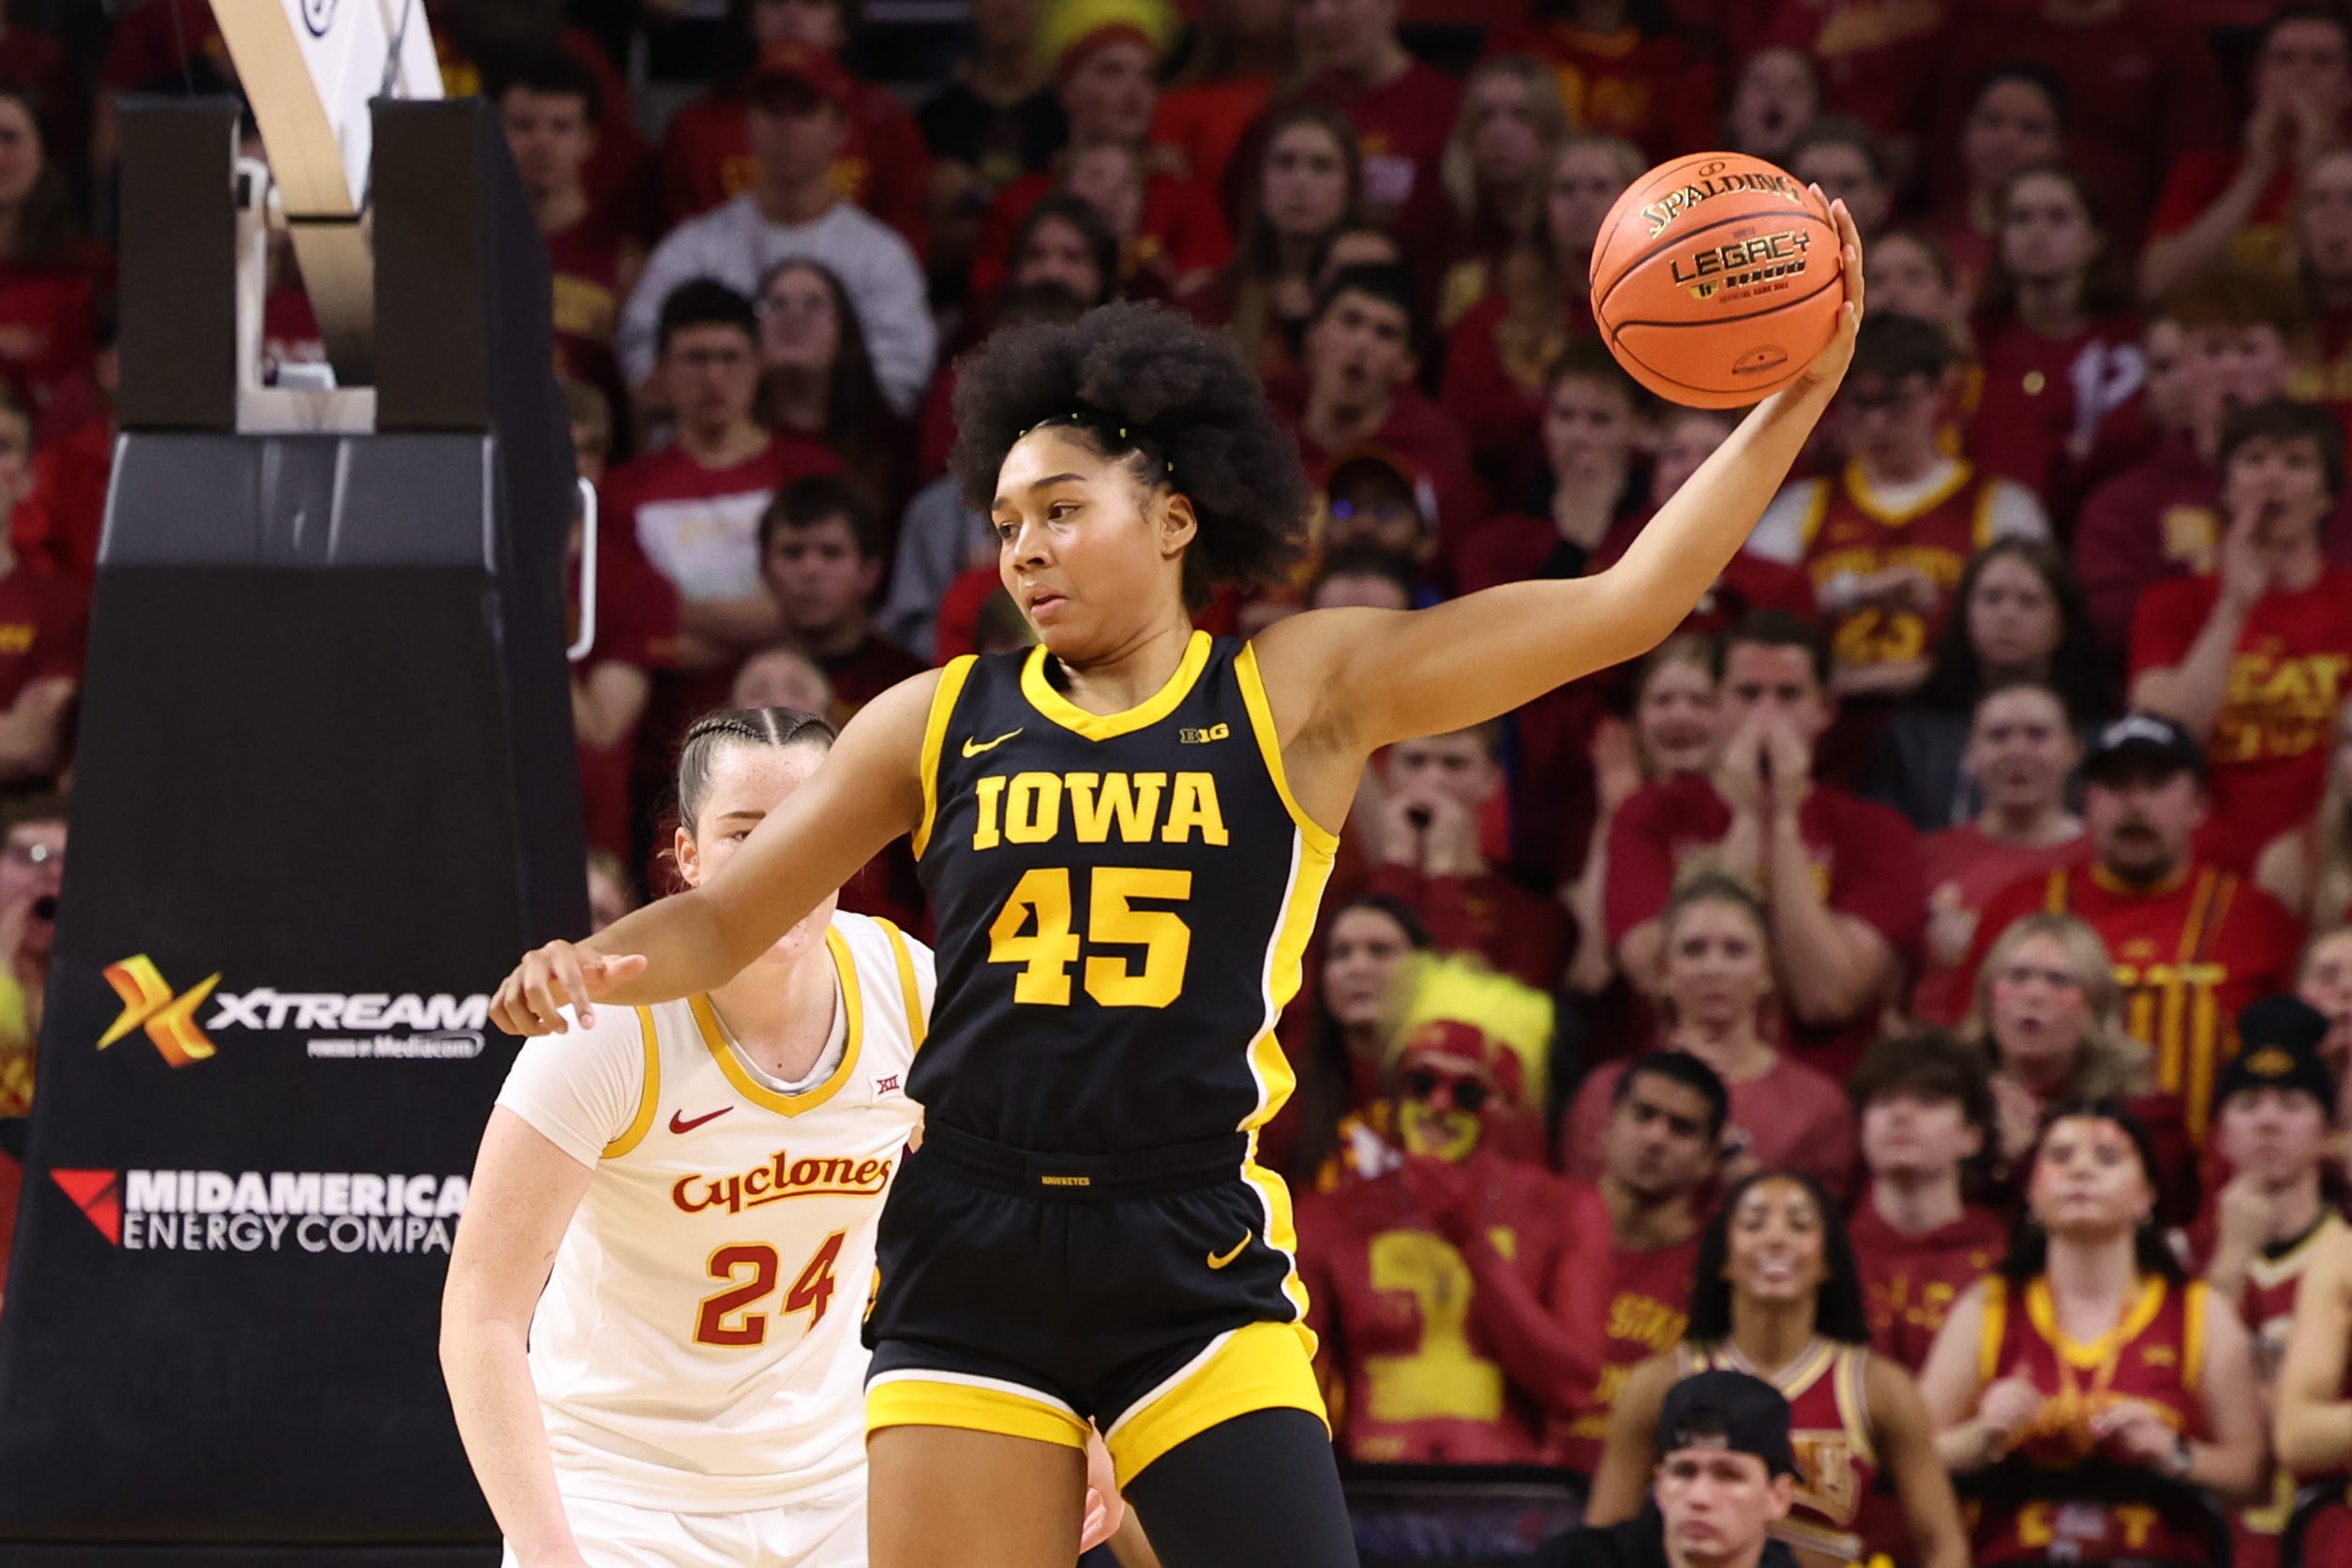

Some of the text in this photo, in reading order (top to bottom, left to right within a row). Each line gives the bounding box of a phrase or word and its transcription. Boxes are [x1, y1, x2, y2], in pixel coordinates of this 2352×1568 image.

[1641, 173, 1804, 238] SPALDING
[1670, 228, 1811, 286] LEGACY
[973, 771, 1229, 851] IOWA
[987, 866, 1192, 1008] 45
[205, 987, 491, 1031] XTREAM
[374, 1033, 475, 1060] Mediacom
[671, 1148, 892, 1216] Cyclones
[124, 1213, 458, 1254] ENERGY COMPA
[692, 1227, 849, 1348] 24
